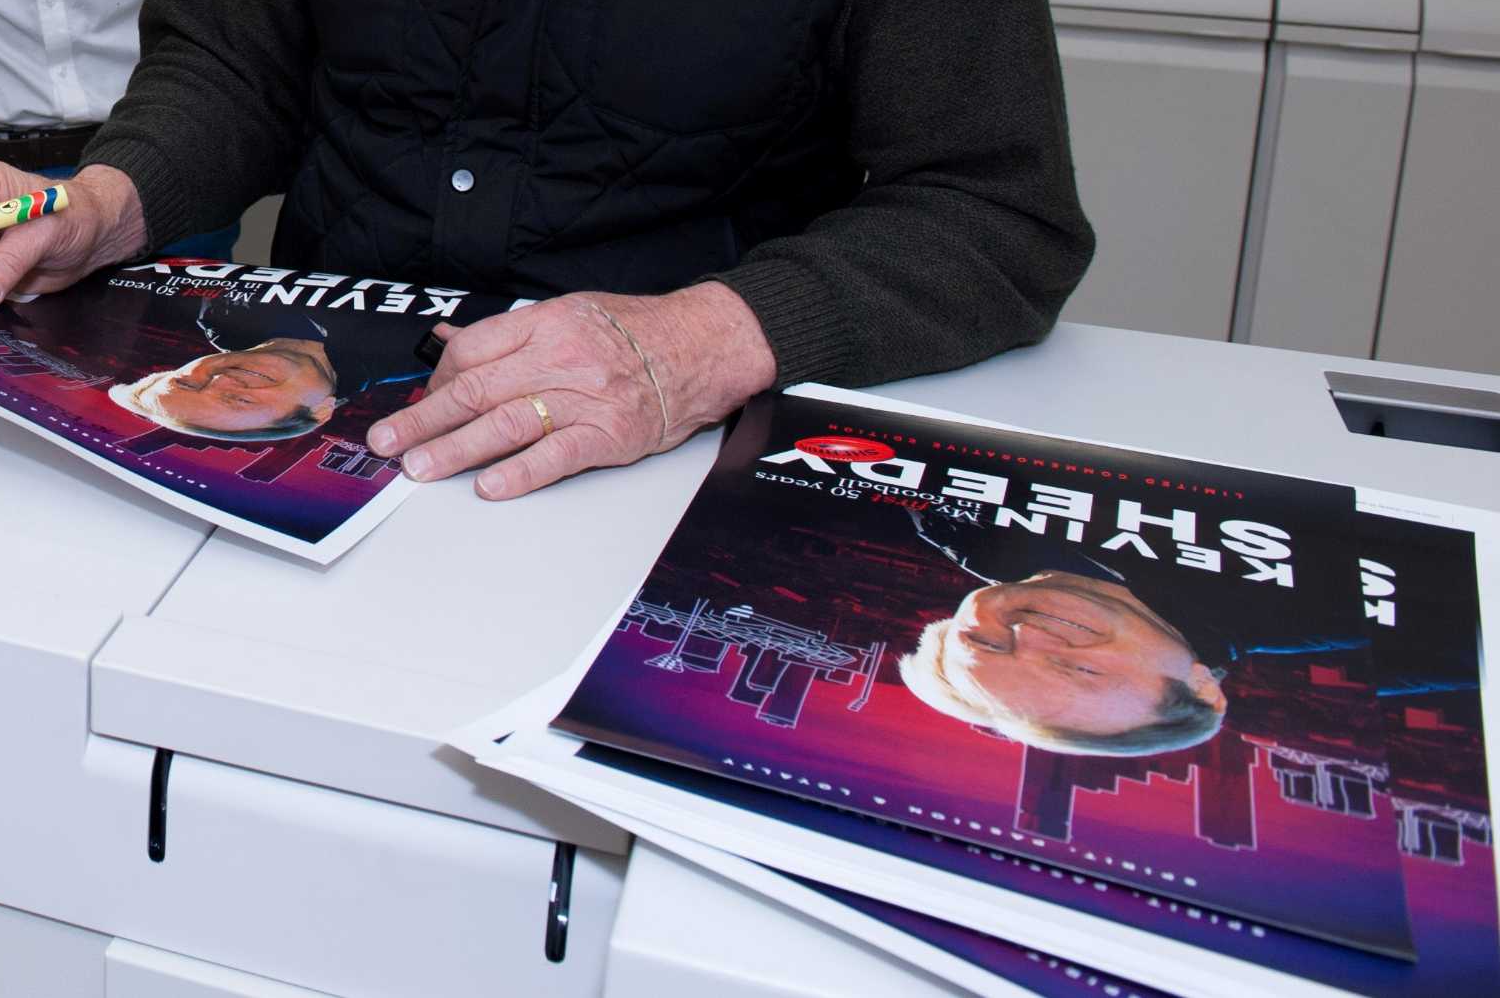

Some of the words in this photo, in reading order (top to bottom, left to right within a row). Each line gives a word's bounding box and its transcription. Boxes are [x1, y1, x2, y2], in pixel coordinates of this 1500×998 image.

[108, 277, 155, 292] years
[156, 285, 179, 296] 50
[165, 275, 241, 291] football
[244, 281, 263, 289] in
[224, 292, 256, 303] My
[259, 283, 463, 318] KEVIN
[828, 423, 917, 445] EDITION
[932, 441, 1129, 481] COMMEMORATIVE
[755, 470, 824, 490] years
[1144, 477, 1245, 500] LIMITED
[830, 487, 863, 500] 50
[839, 477, 945, 506] football
[758, 448, 1293, 561] SHEEDY
[870, 493, 931, 512] first
[956, 498, 982, 510] in
[937, 505, 982, 522] My
[994, 506, 1294, 588] KEVIN
